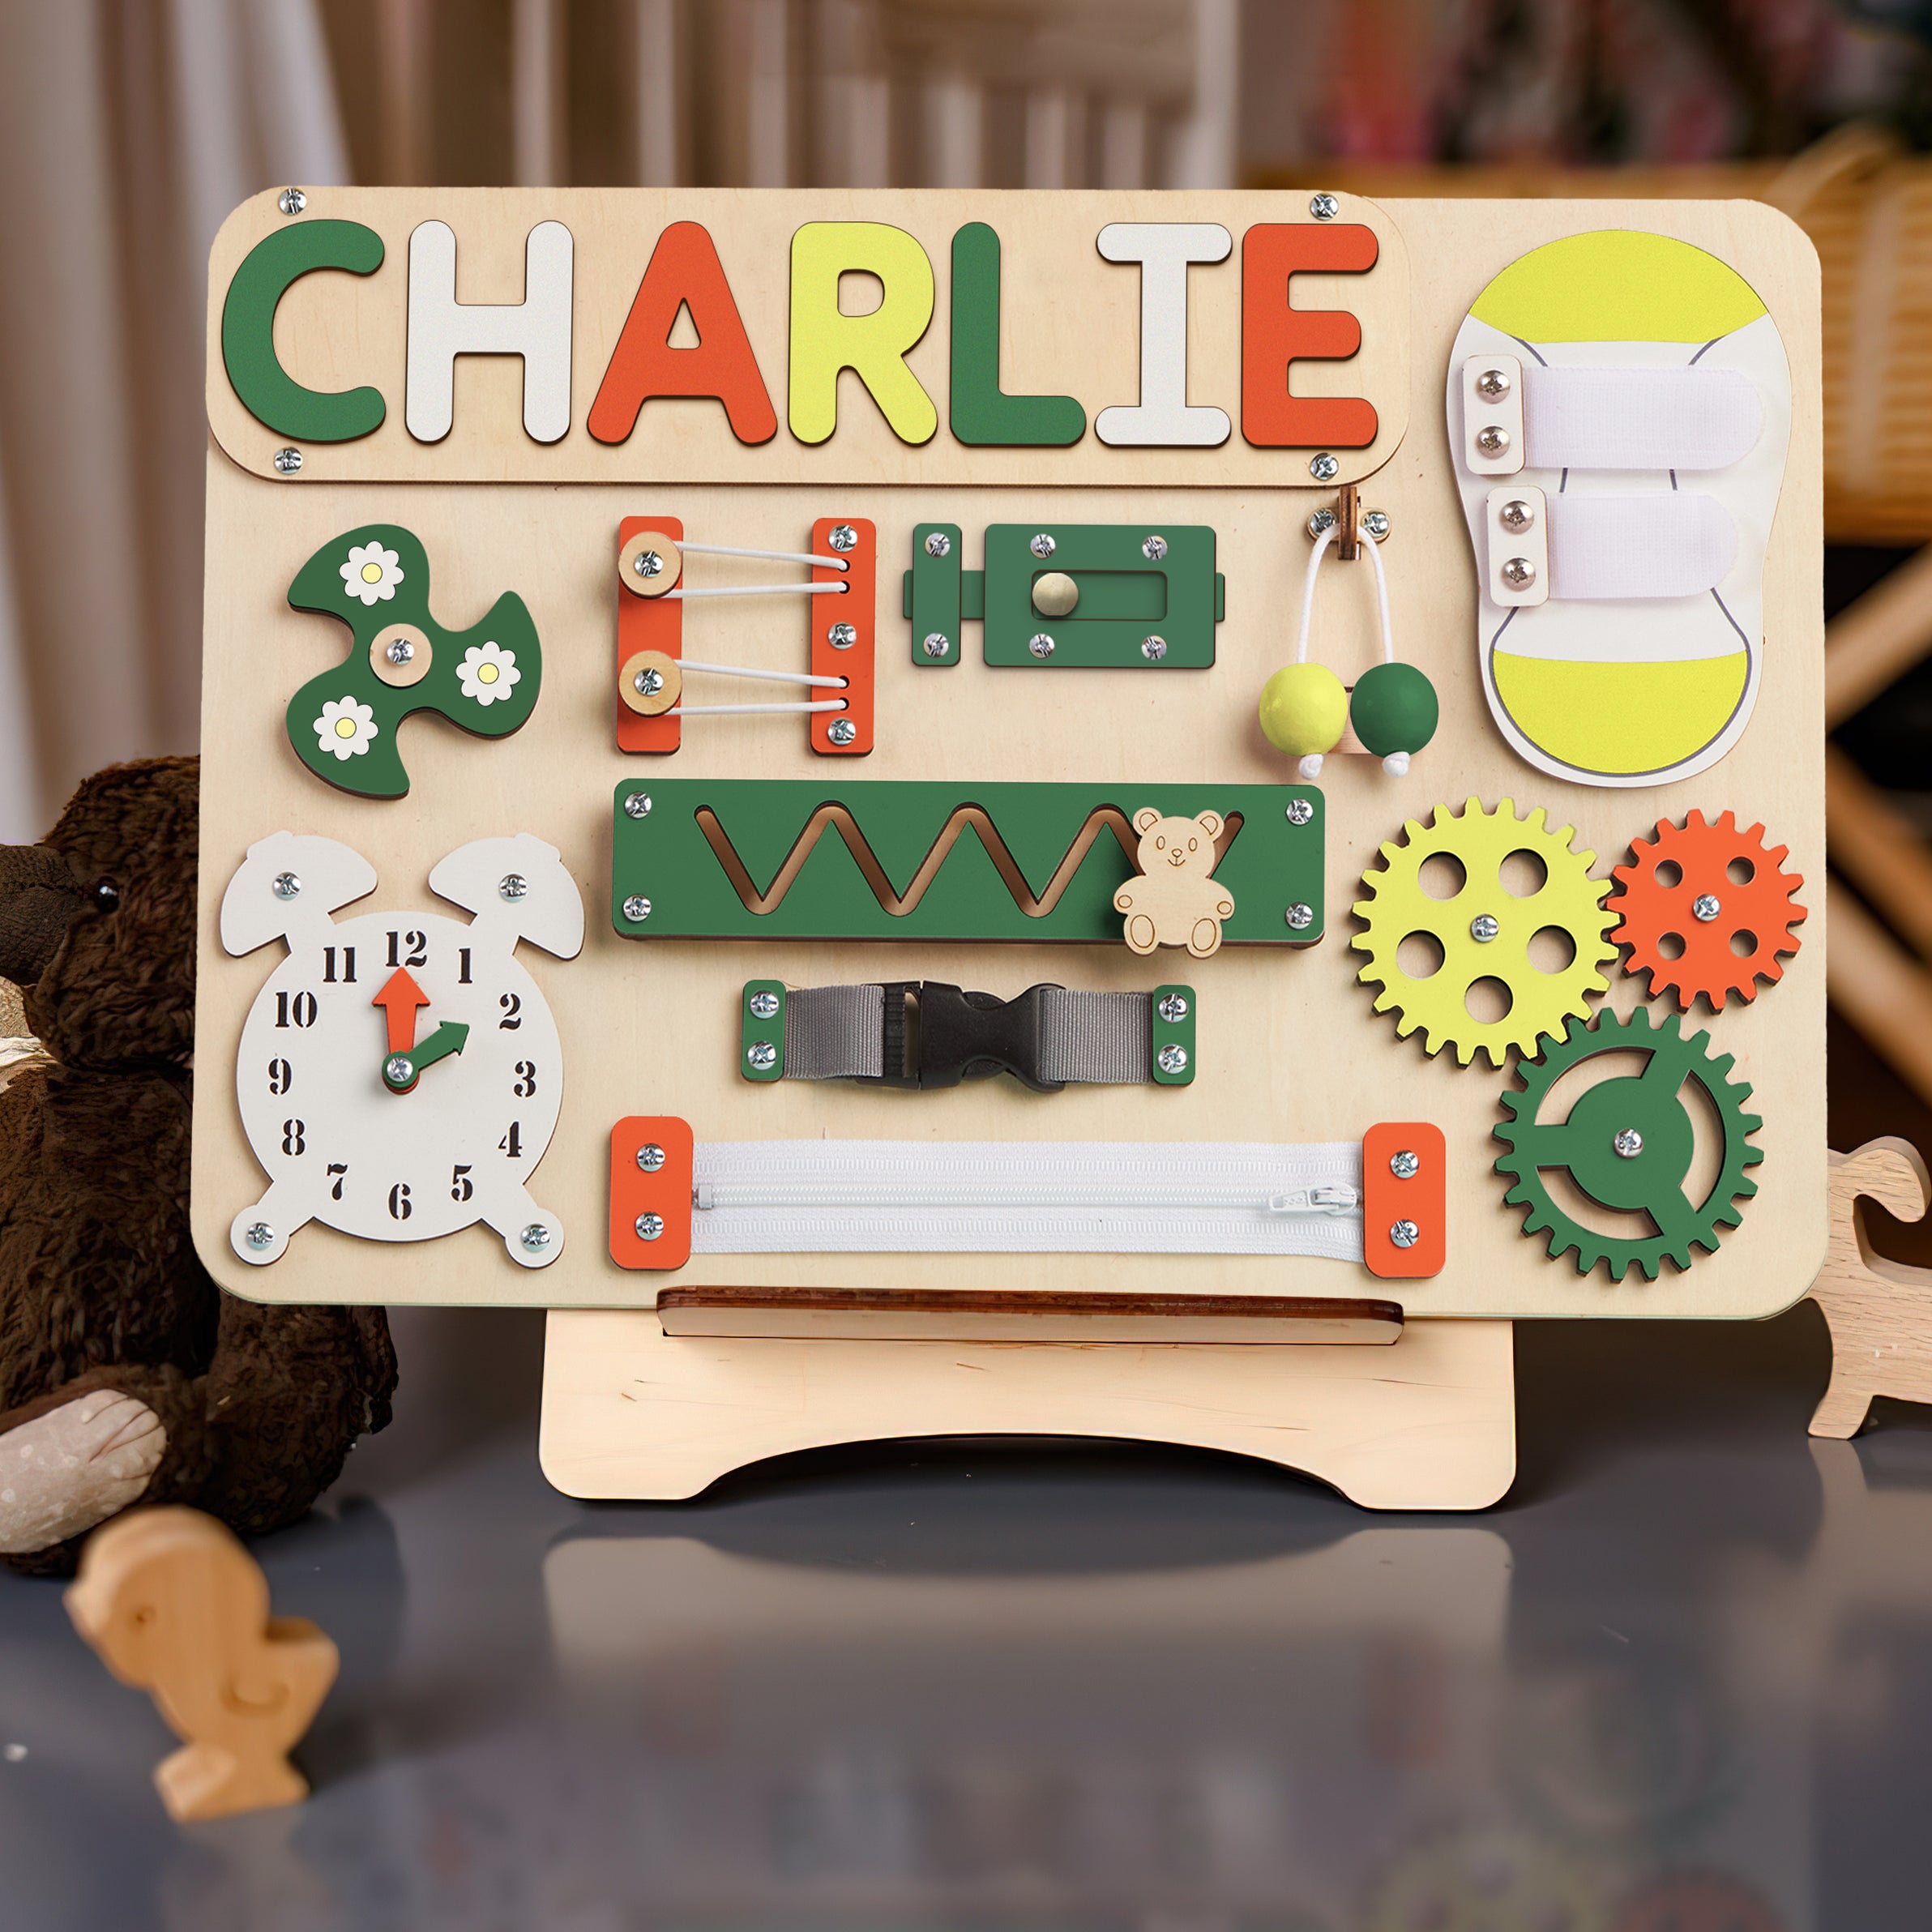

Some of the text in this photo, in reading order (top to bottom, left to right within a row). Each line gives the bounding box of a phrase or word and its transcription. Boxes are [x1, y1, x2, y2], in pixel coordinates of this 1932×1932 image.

[221, 219, 1378, 448] CHARLIE
[323, 947, 357, 983] 11
[385, 931, 427, 968] 12
[458, 947, 473, 984] 1
[275, 991, 318, 1028] 10
[499, 993, 521, 1030] 2
[268, 1058, 292, 1095] 9
[513, 1061, 536, 1097] 3
[282, 1118, 306, 1156] 8
[498, 1121, 523, 1158] 4
[327, 1163, 348, 1201] 7
[451, 1165, 473, 1202] 5
[388, 1183, 412, 1220] 6
